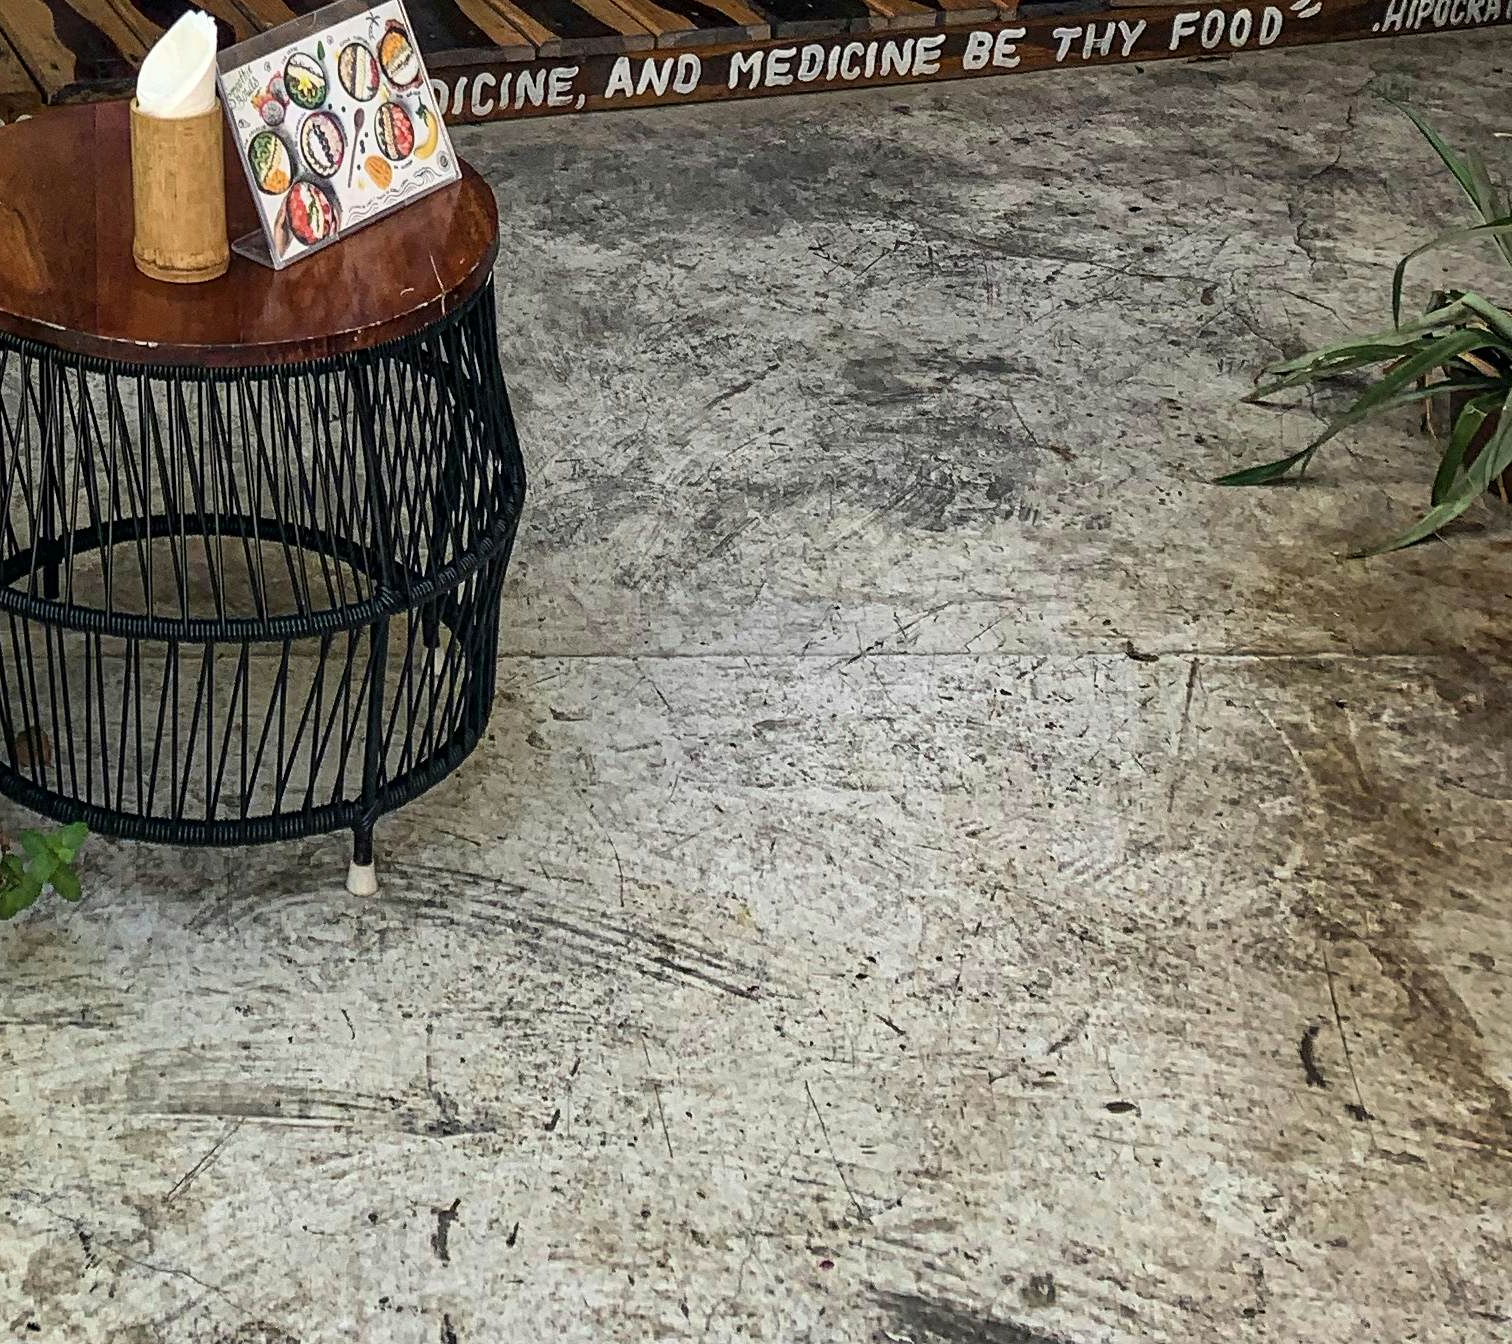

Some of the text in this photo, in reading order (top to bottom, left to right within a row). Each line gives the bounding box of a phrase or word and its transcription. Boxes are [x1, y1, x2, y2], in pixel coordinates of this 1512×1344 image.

[429, 65, 586, 117] DICINE,
[604, 53, 702, 99] AND
[729, 34, 948, 91] MEDICINE
[963, 27, 1028, 71] BE
[1053, 19, 1148, 61] THY
